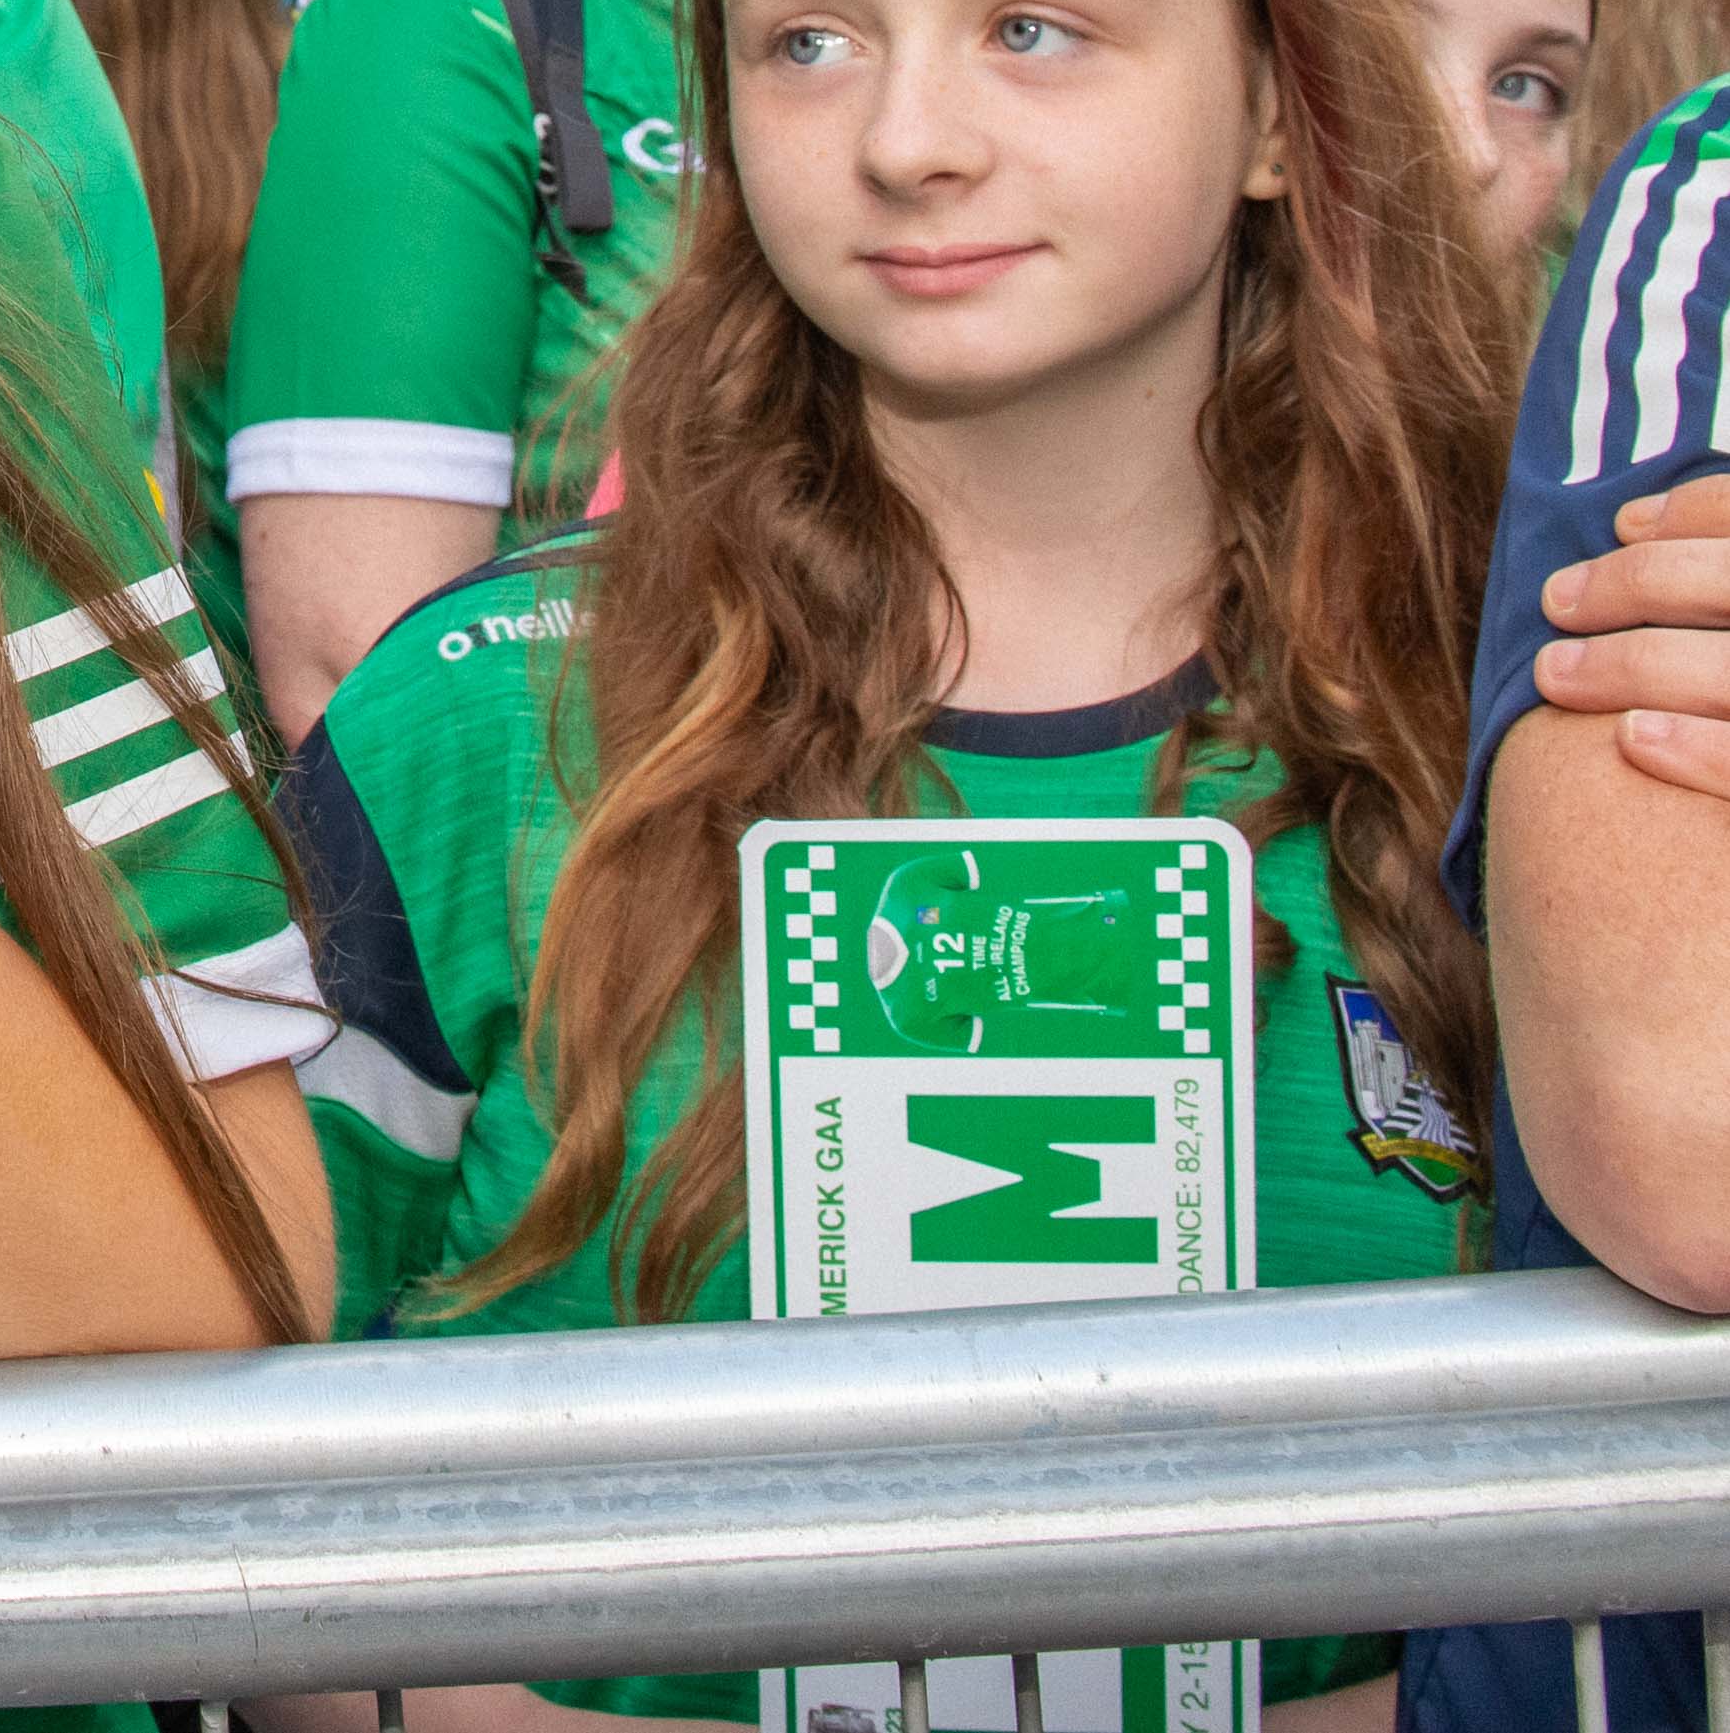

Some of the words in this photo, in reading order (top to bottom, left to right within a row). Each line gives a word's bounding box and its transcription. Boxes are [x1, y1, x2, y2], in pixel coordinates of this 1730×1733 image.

[932, 932, 966, 974] 12
[971, 934, 988, 972] TIME
[1009, 910, 1032, 996] CHAMPIONS
[814, 1095, 843, 1174] GAA
[1173, 1077, 1204, 1174] 82,479
